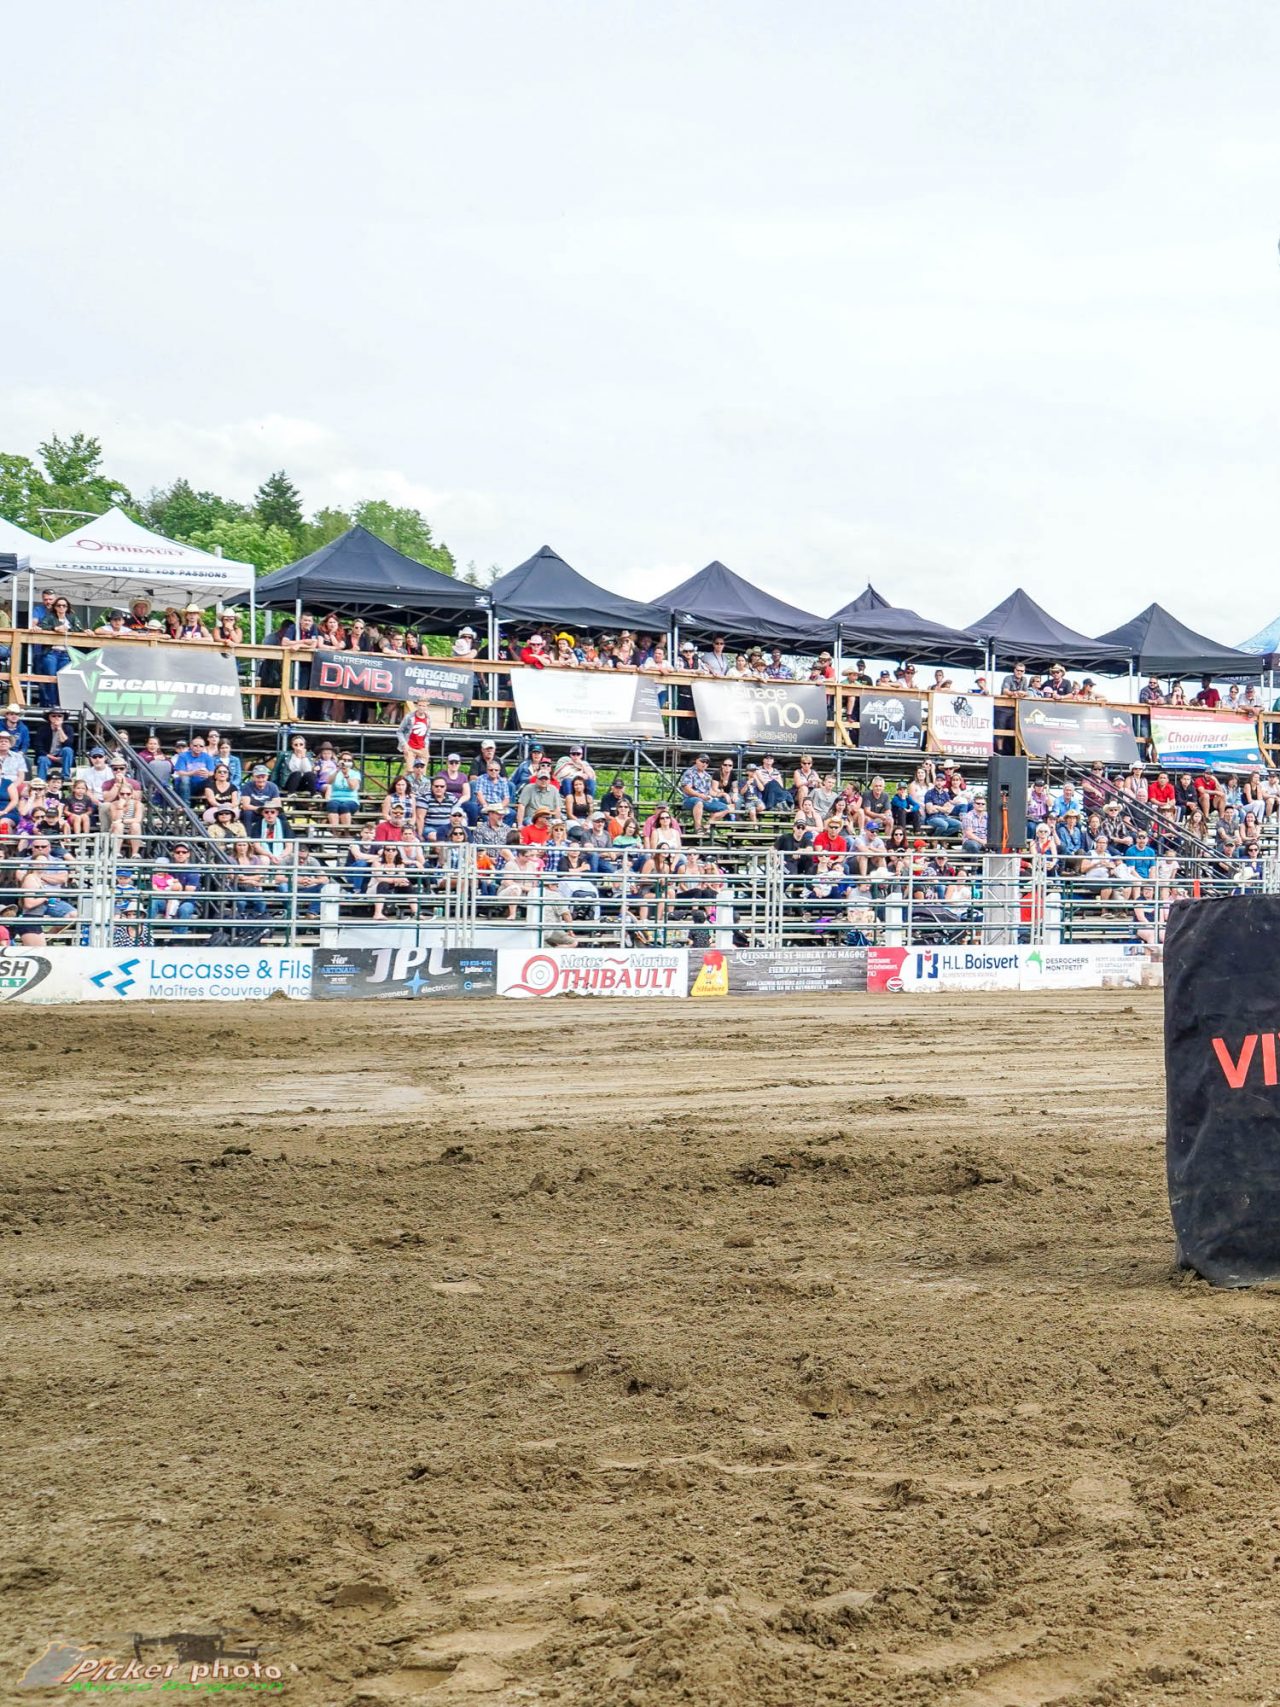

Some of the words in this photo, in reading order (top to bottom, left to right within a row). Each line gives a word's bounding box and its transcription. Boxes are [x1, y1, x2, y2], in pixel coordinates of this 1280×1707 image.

[72, 565, 134, 573] PARTENAIRE
[178, 570, 228, 579] PASSIONS
[333, 655, 383, 668] ENTREPRISE
[319, 661, 393, 694] DMB
[404, 666, 470, 685] DÉNEIGEMENT
[98, 678, 236, 697] EXCAVATION
[93, 691, 177, 718] MV
[870, 713, 890, 732] JTD
[935, 715, 959, 729] PNEUS
[960, 716, 991, 729] GOULET
[1167, 731, 1229, 744] Chouinard
[330, 954, 349, 965] Fier
[560, 953, 604, 968] Motos
[629, 953, 679, 968] Marine
[733, 950, 782, 961] RÔTISSERIE
[783, 951, 826, 959] ST-HUBERT
[827, 951, 837, 959] DE
[837, 950, 866, 959] MAGOG
[151, 959, 250, 979] Lacasse
[257, 959, 273, 979] &
[279, 960, 312, 979] Fils
[365, 947, 454, 983] JPL
[559, 968, 678, 990] THIBAULT
[149, 984, 205, 997] Maîtres
